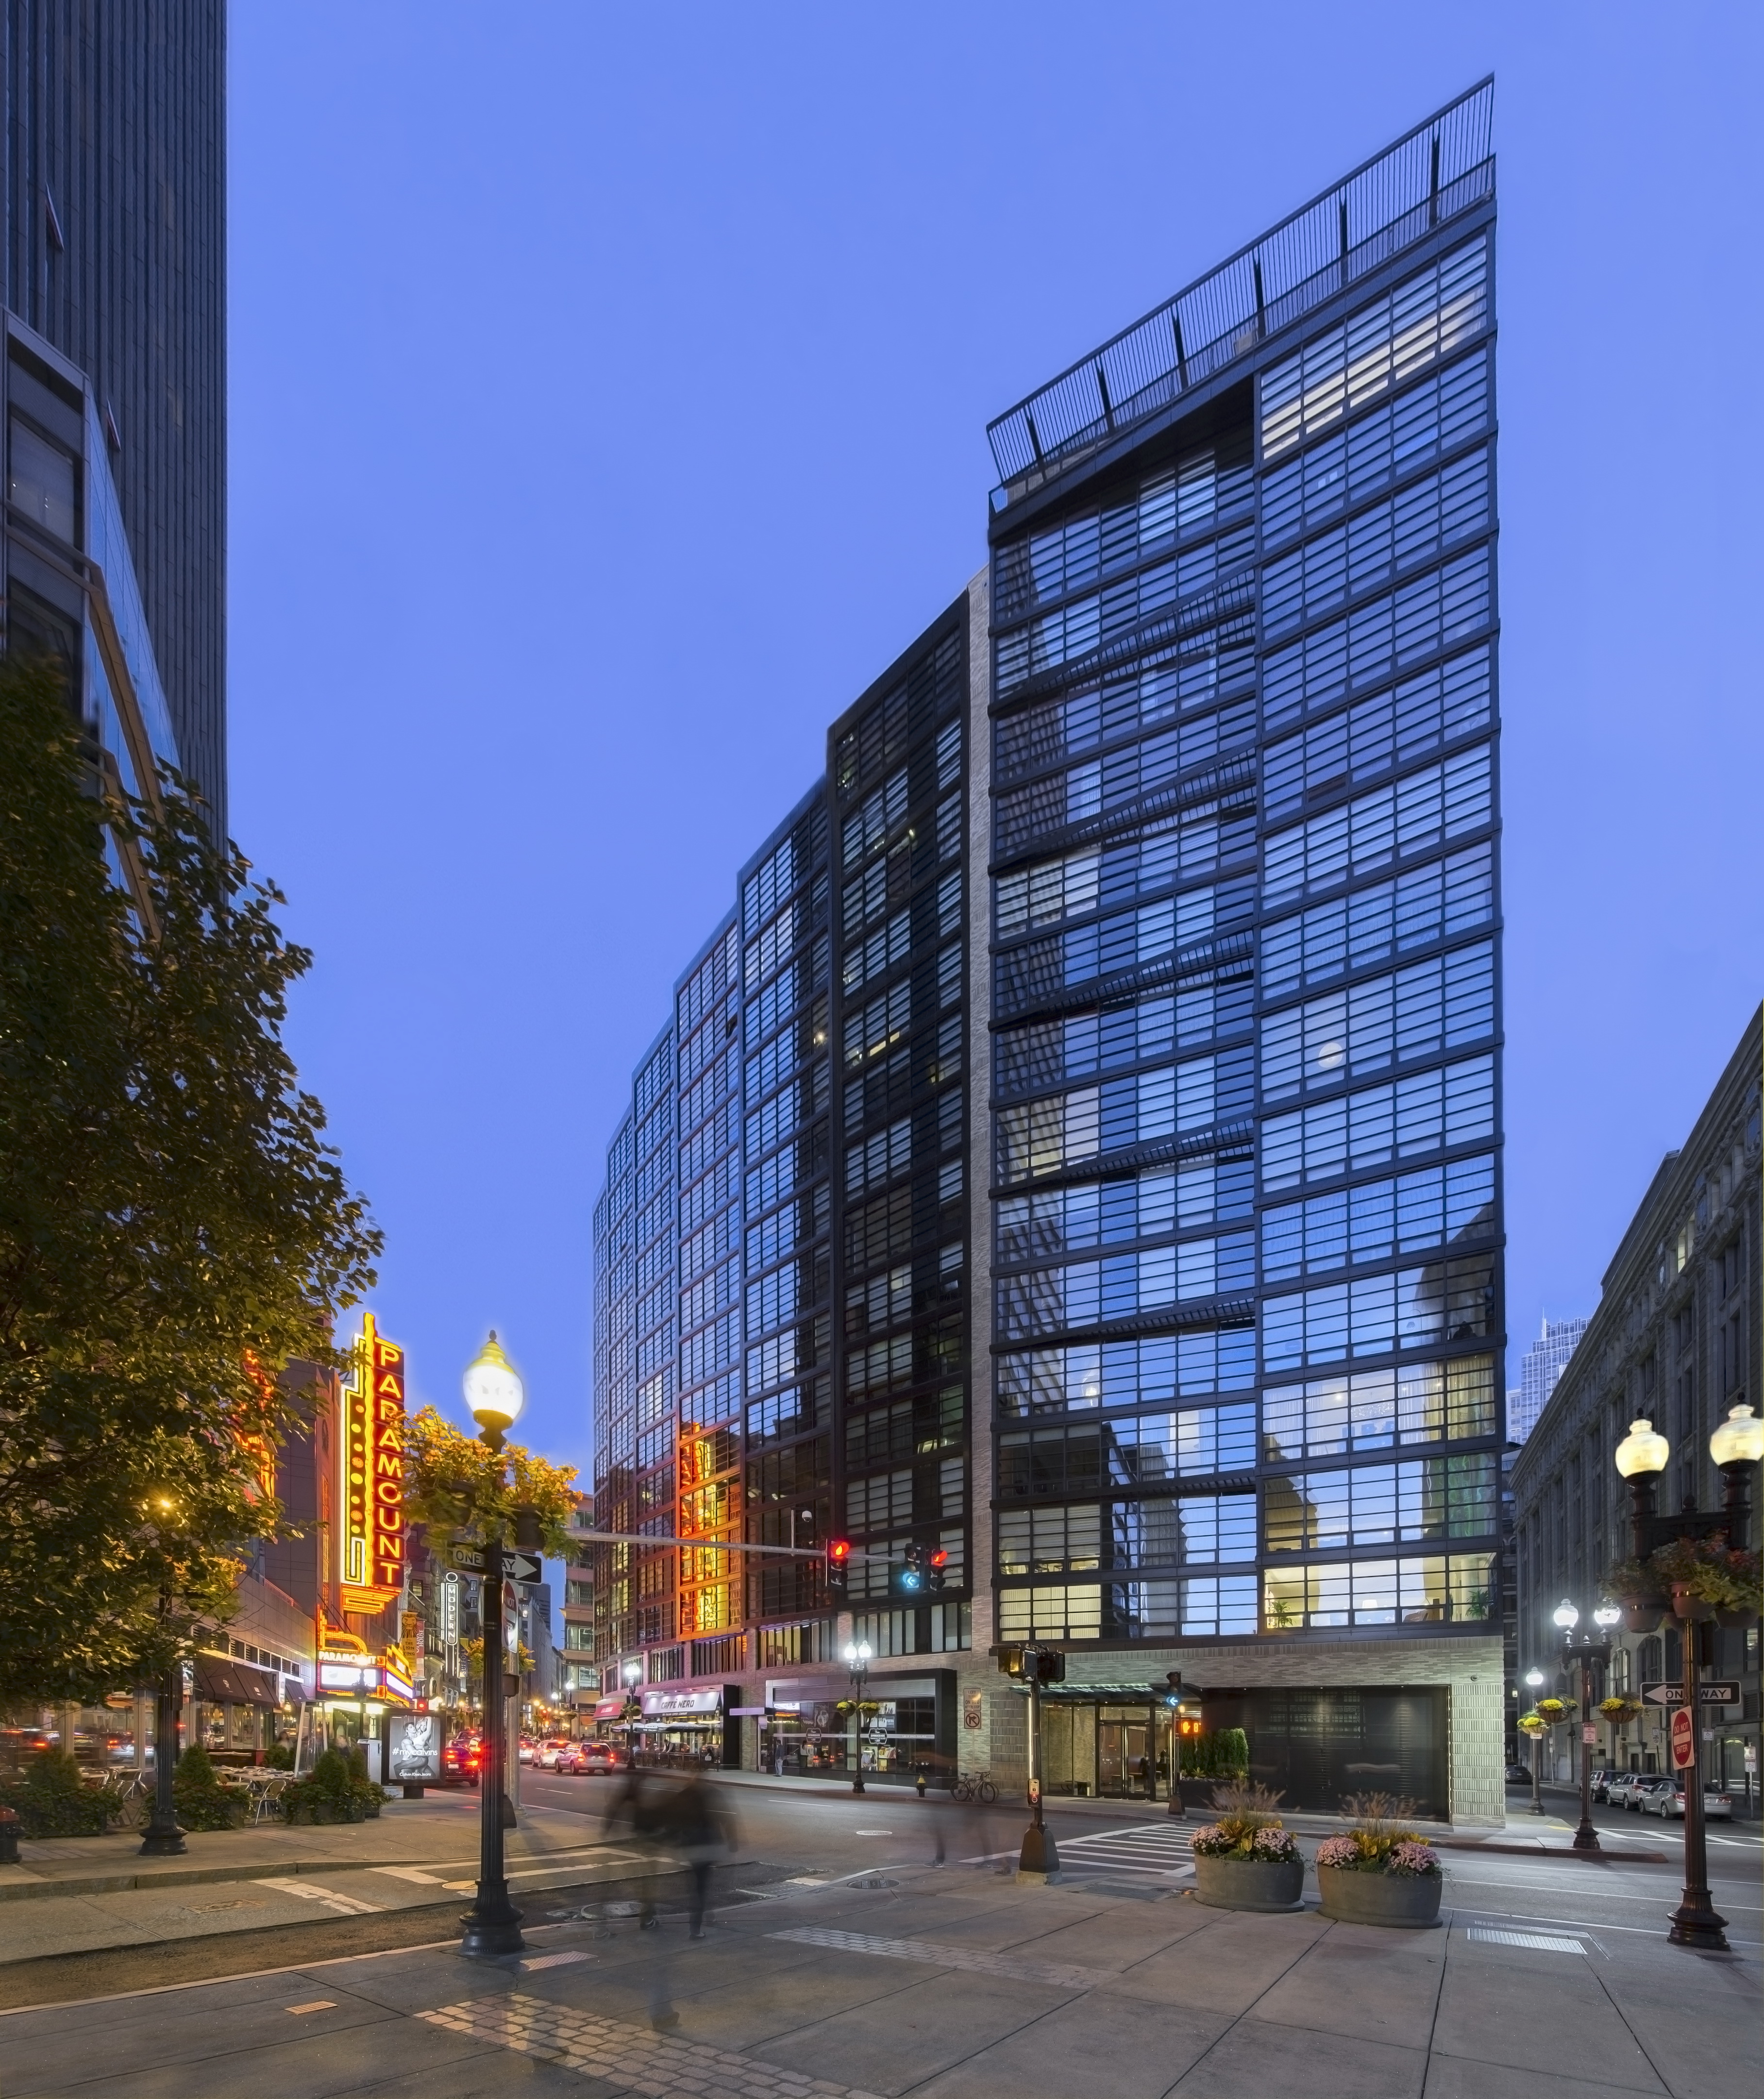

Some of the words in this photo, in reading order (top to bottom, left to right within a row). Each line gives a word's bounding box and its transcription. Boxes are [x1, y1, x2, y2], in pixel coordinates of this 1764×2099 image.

[455, 1550, 481, 1565] ONE
[502, 1559, 516, 1571] AY
[1665, 1690, 1683, 1699] ON
[678, 1700, 695, 1708] NERO
[1674, 1725, 1680, 1734] DO
[392, 1747, 438, 1758] #mycalvins
[1676, 1744, 1688, 1754] ENTER
